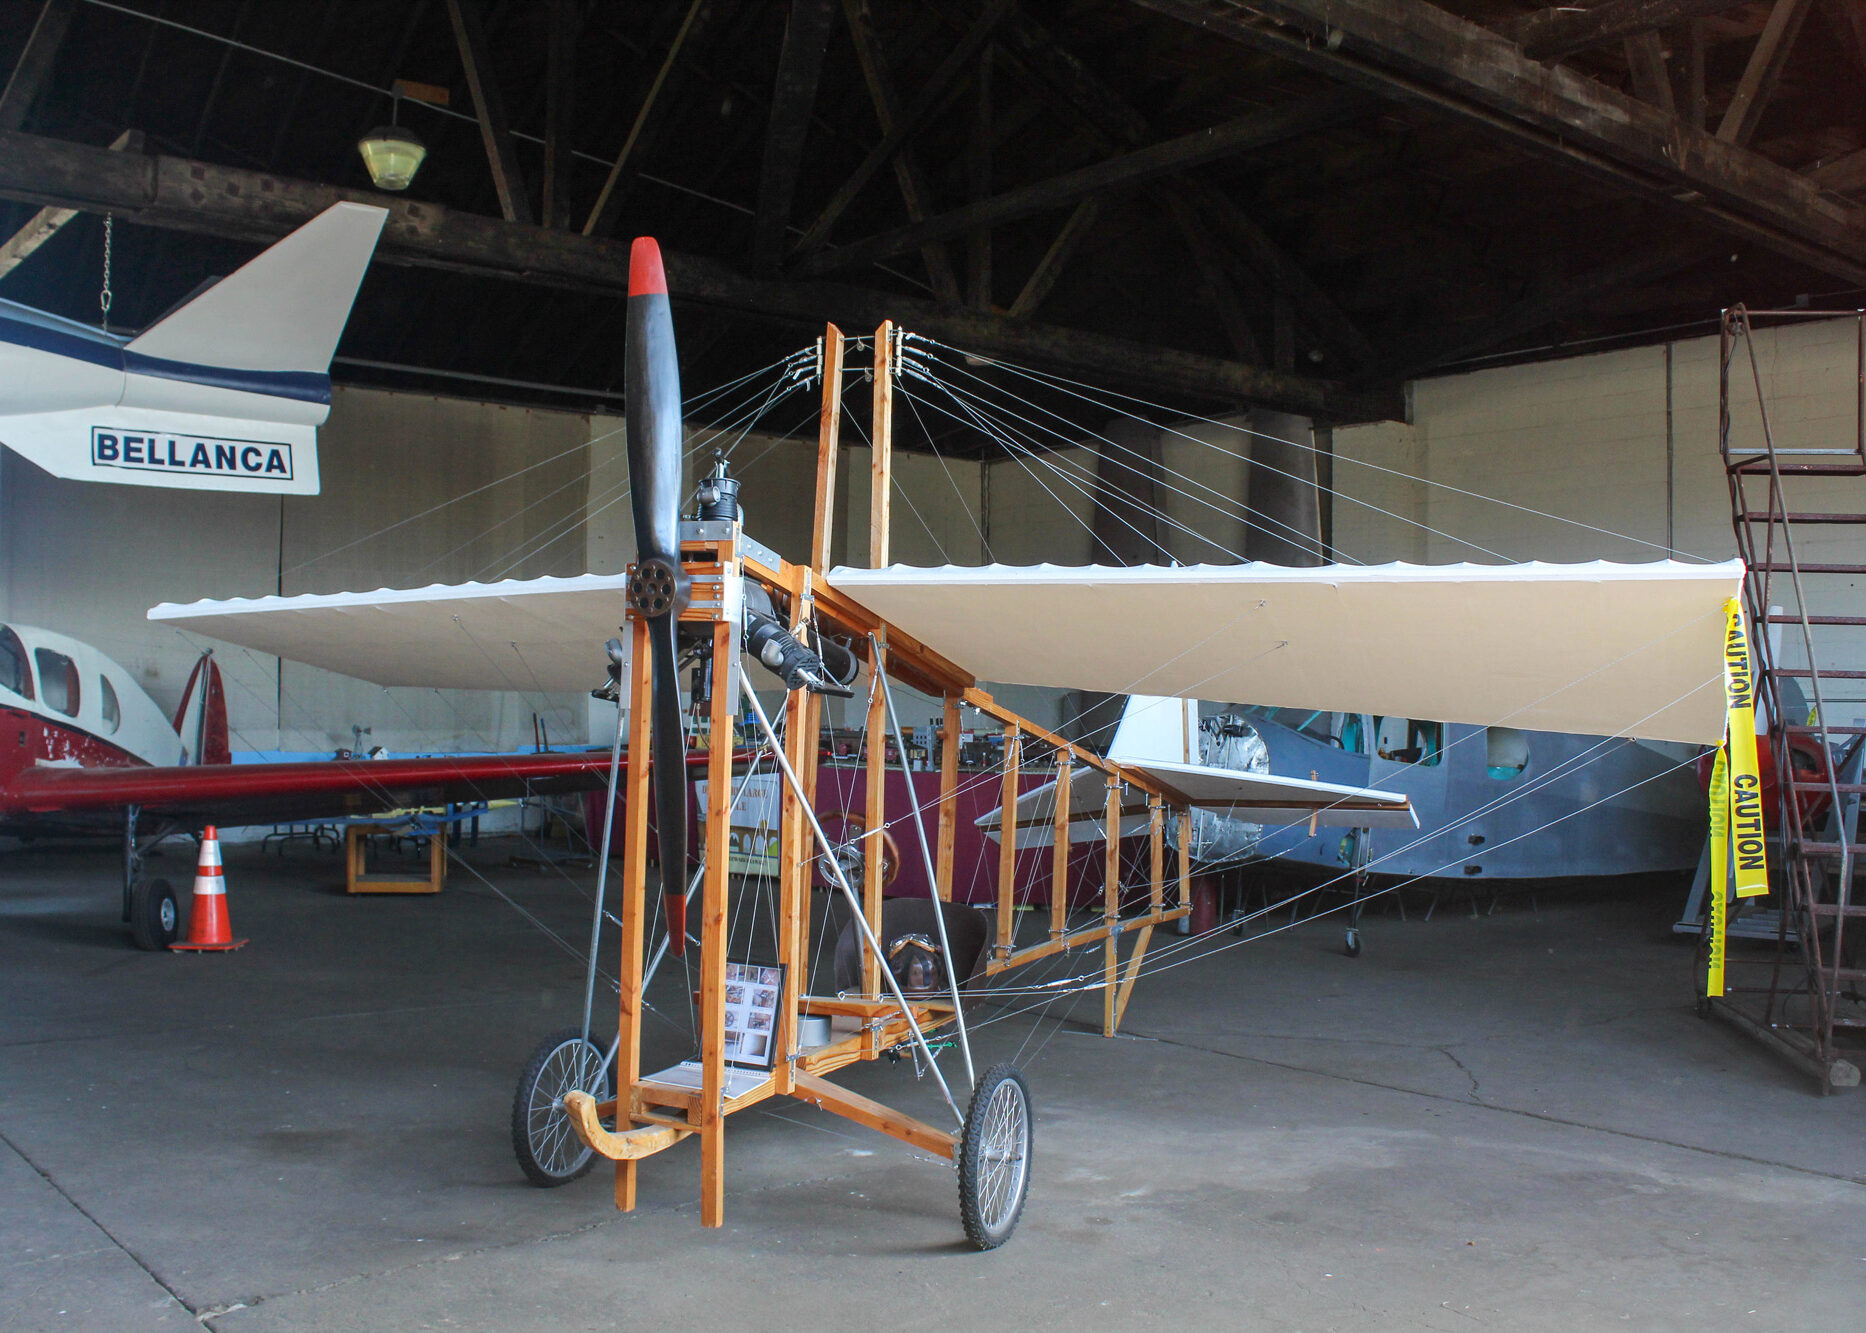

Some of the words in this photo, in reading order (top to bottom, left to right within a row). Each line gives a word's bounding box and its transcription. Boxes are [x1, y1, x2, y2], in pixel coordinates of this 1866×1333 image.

[97, 433, 287, 474] BELLANCA
[1726, 613, 1752, 709] CAUTION
[1734, 774, 1764, 870] CAUTION
